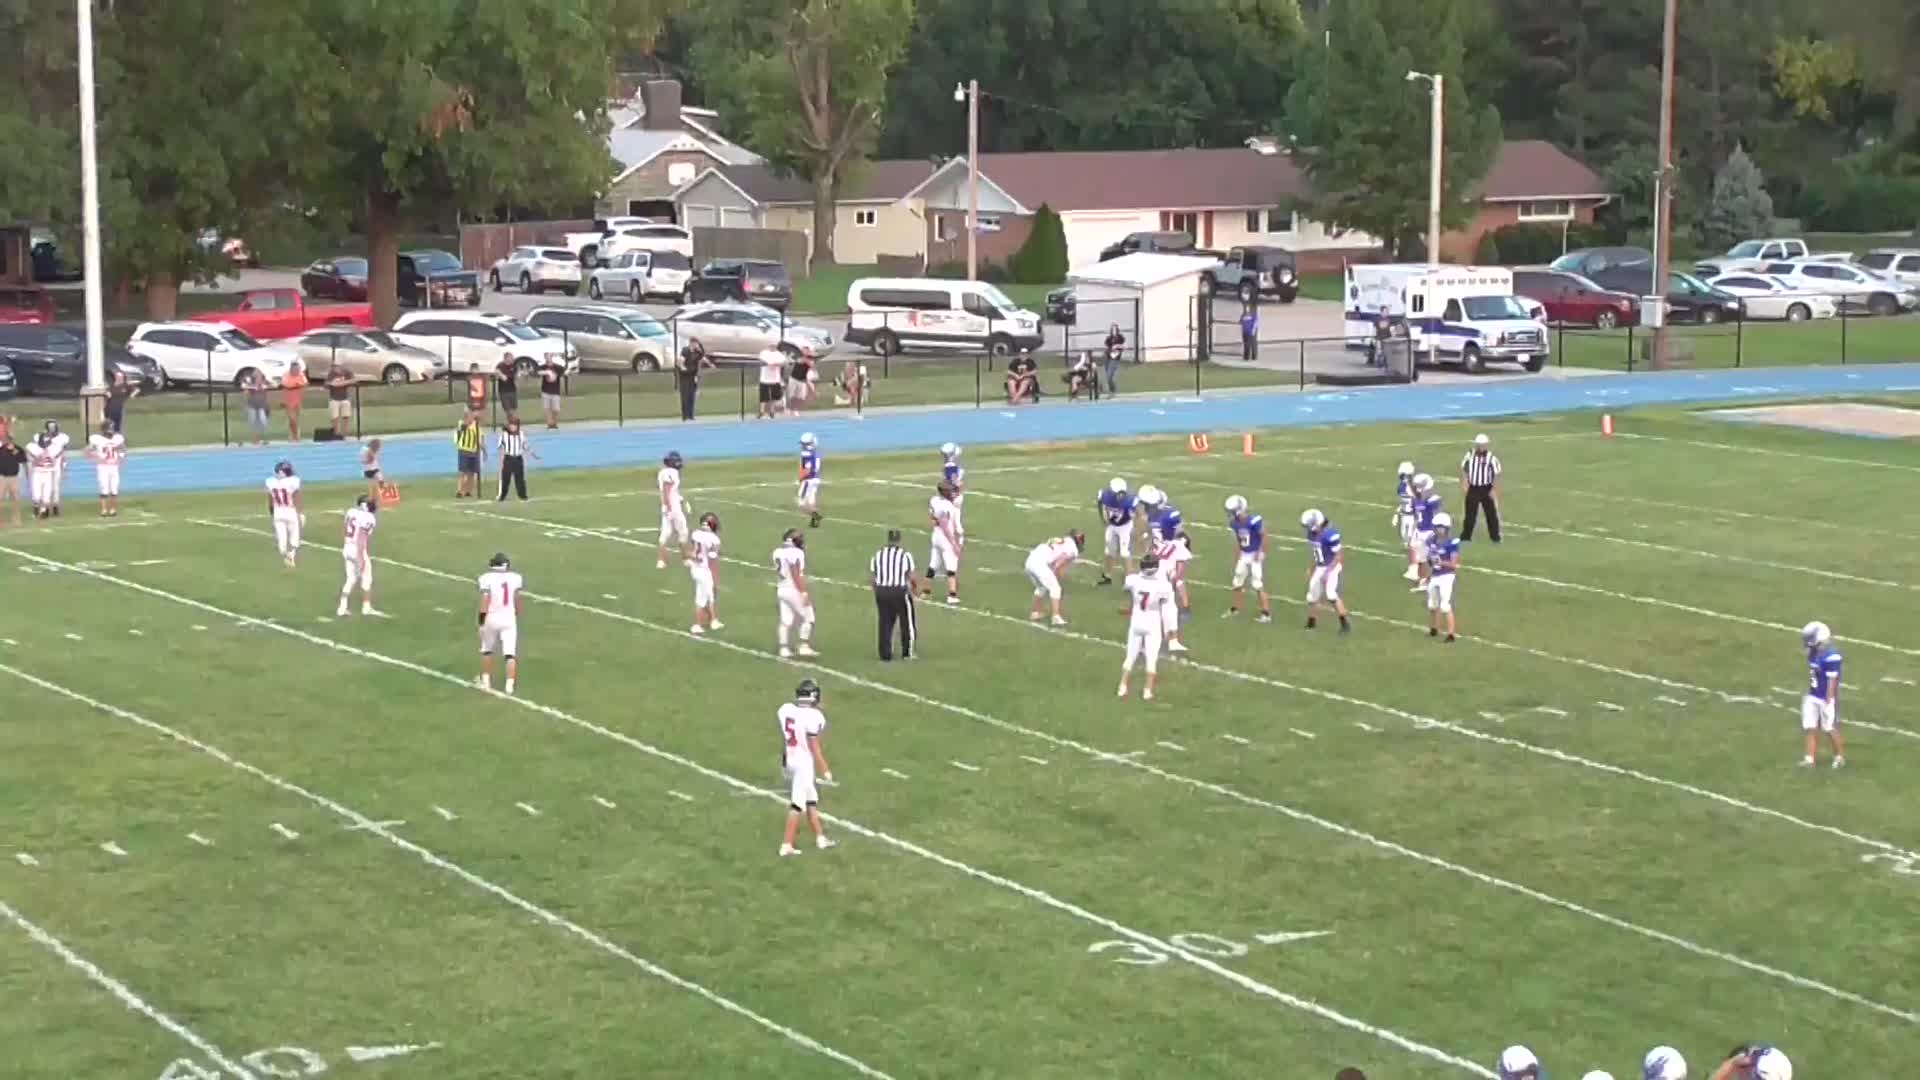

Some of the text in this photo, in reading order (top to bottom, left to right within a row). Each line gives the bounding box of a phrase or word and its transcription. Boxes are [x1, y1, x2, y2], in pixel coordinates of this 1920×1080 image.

[272, 487, 289, 506] 11
[501, 581, 509, 607] 1
[1138, 591, 1150, 611] 7
[784, 716, 798, 747] 5
[1087, 932, 1249, 964] 30
